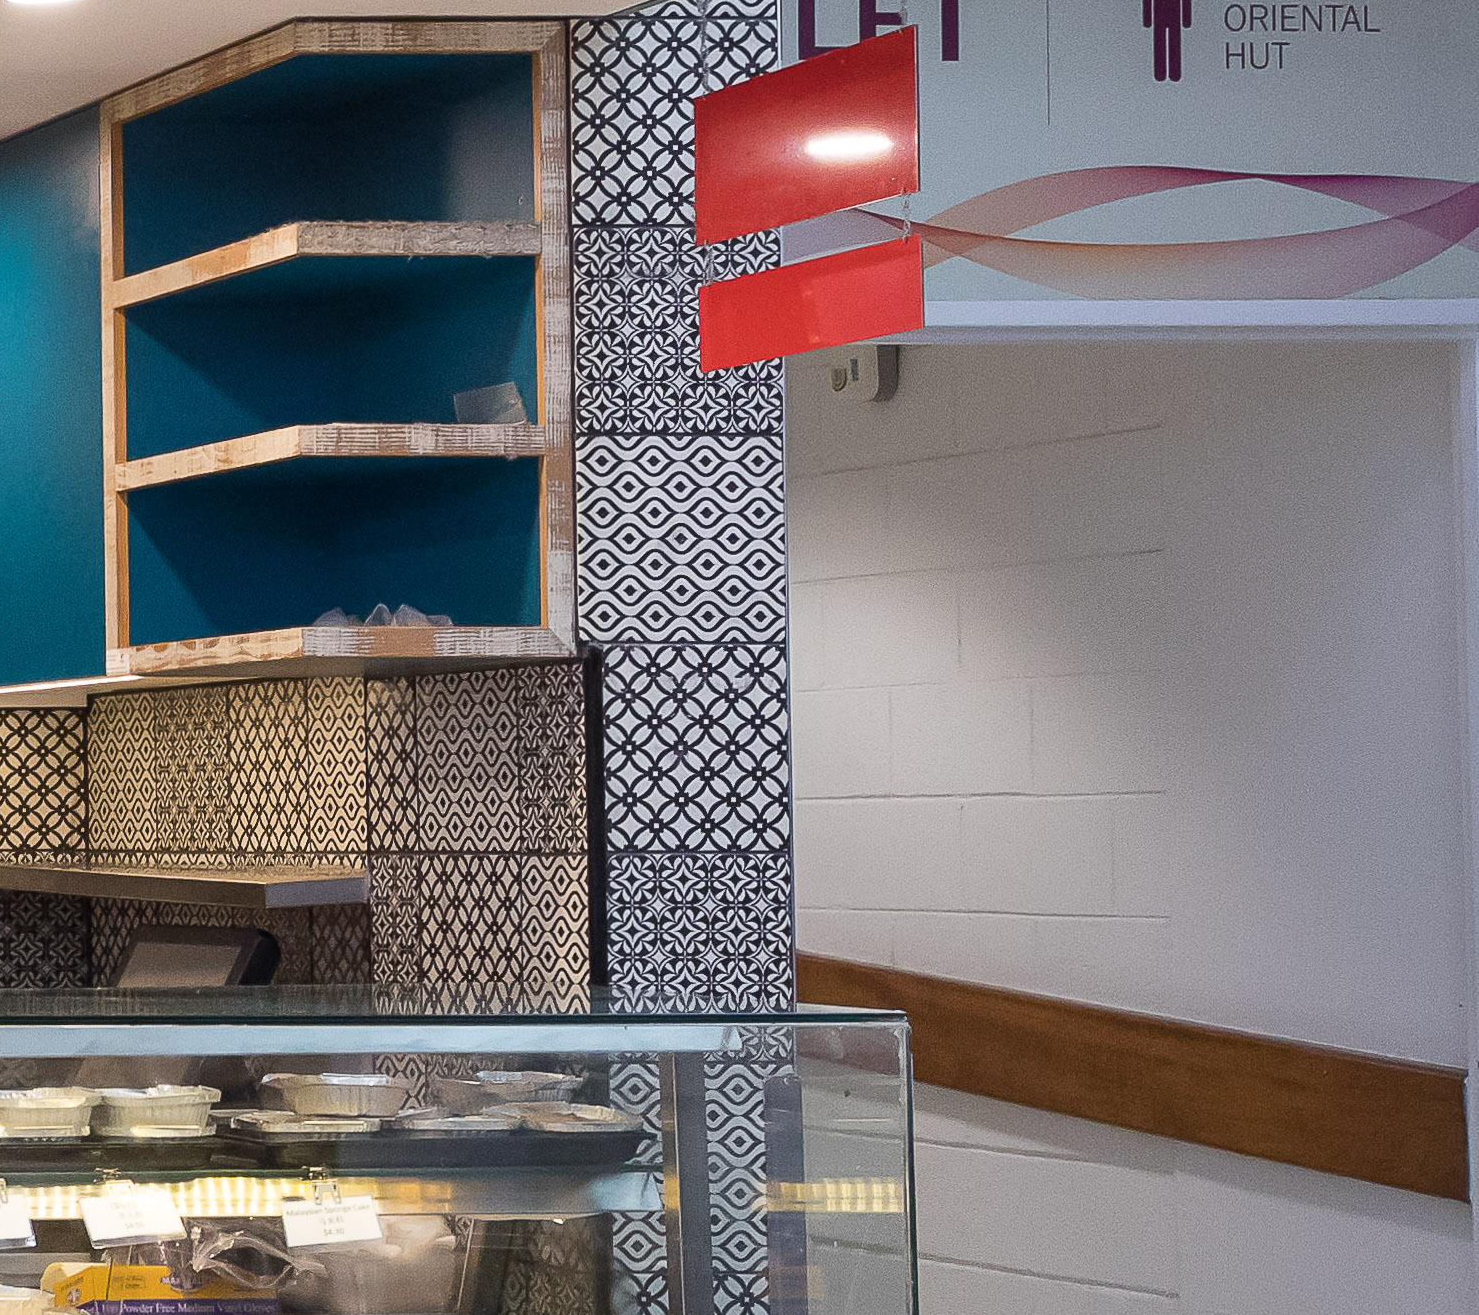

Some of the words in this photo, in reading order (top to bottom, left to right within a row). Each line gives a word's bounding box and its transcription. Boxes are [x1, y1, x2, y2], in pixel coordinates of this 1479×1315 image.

[1224, 4, 1380, 32] ORIENTAL
[1226, 42, 1290, 69] HUT
[121, 1302, 153, 1313] Powder
[156, 1302, 175, 1313] Free
[178, 1302, 215, 1313] Medium
